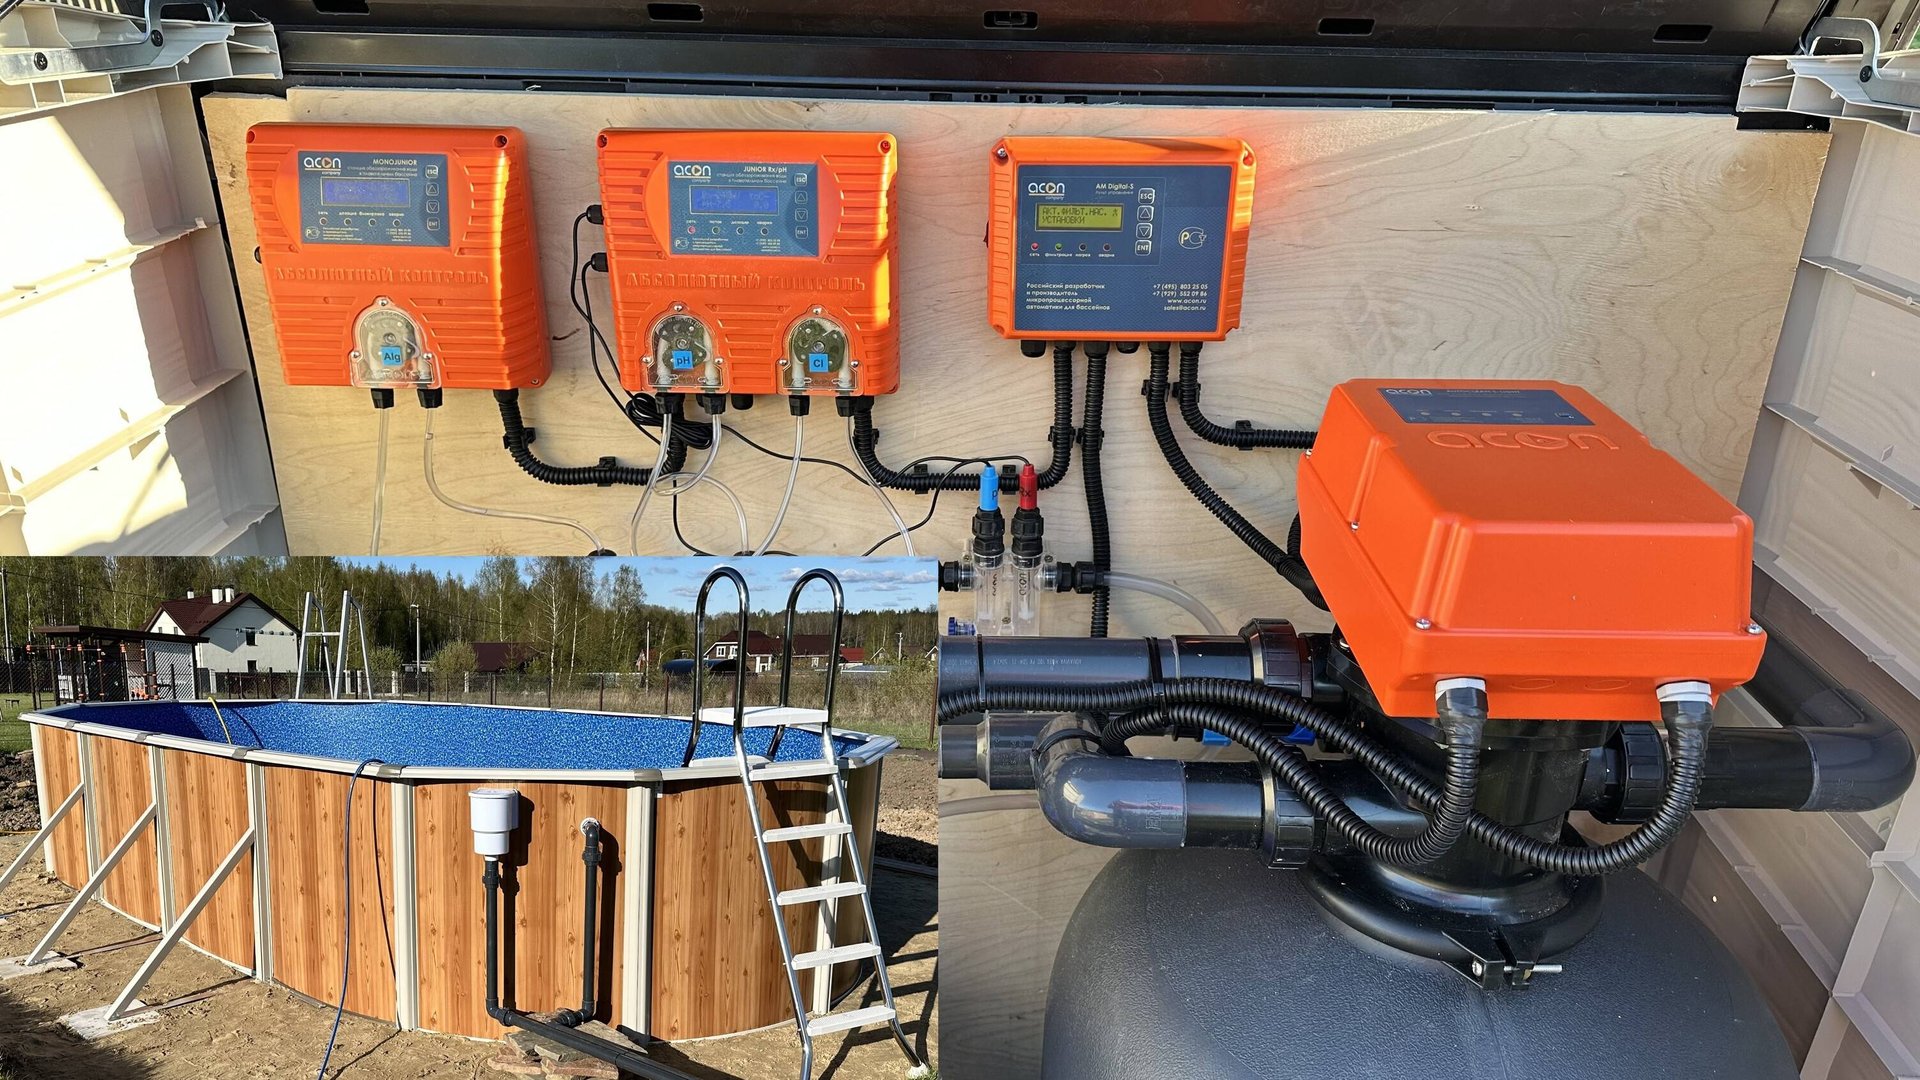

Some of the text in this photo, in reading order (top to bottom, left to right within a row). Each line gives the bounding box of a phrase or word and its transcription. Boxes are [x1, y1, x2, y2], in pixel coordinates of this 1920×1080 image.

[303, 157, 341, 168] acon
[673, 164, 711, 176] acon
[1028, 182, 1065, 193] acon
[274, 267, 394, 282] АБСОЛЮТНЫЙ
[625, 272, 866, 291] АБСОЛЮТНЫЙ КОНТРОЛЬ
[384, 352, 401, 363] Alg
[676, 356, 690, 366] pH
[1426, 430, 1620, 450] acon
